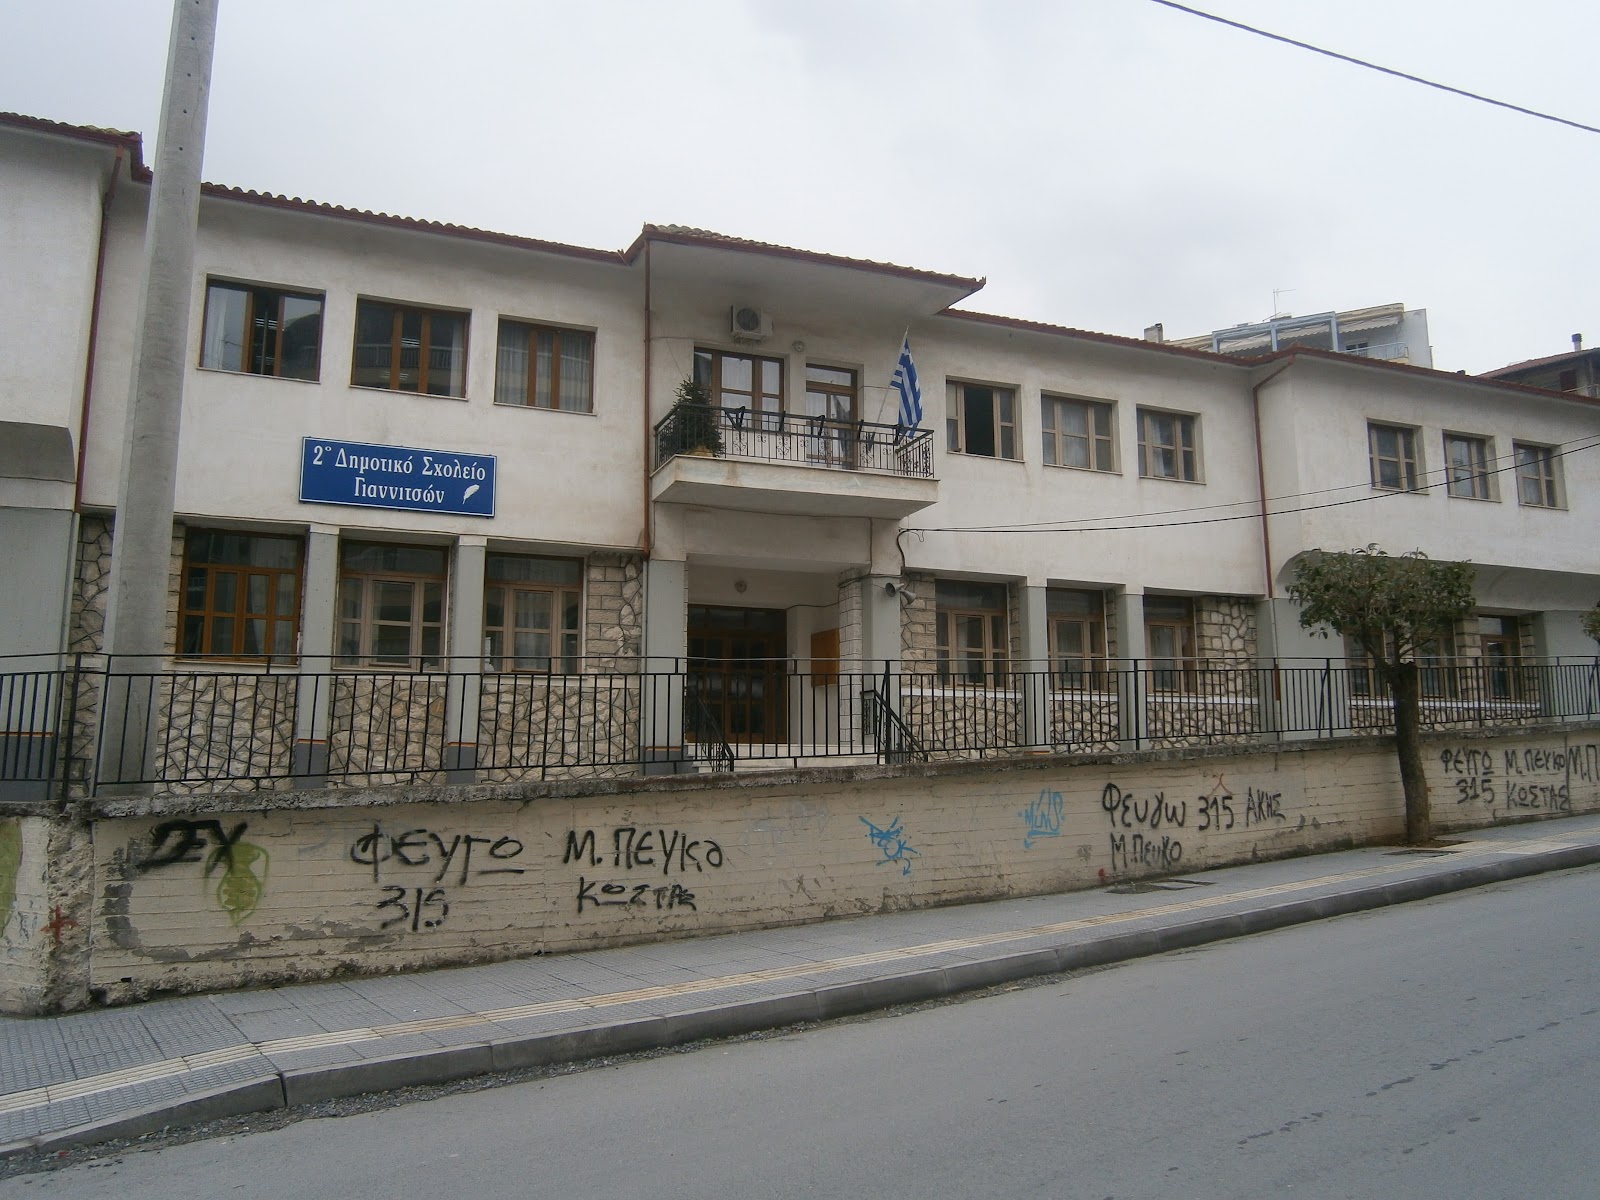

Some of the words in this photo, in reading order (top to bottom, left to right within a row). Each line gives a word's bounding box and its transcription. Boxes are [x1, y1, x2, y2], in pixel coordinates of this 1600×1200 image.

[335, 447, 413, 474] Δημοτικό
[421, 456, 486, 481] Σχολείο
[354, 476, 445, 503] Γιαννιτσών
[1455, 777, 1495, 804] 315
[1198, 795, 1235, 831] 315
[376, 885, 449, 932] 315
